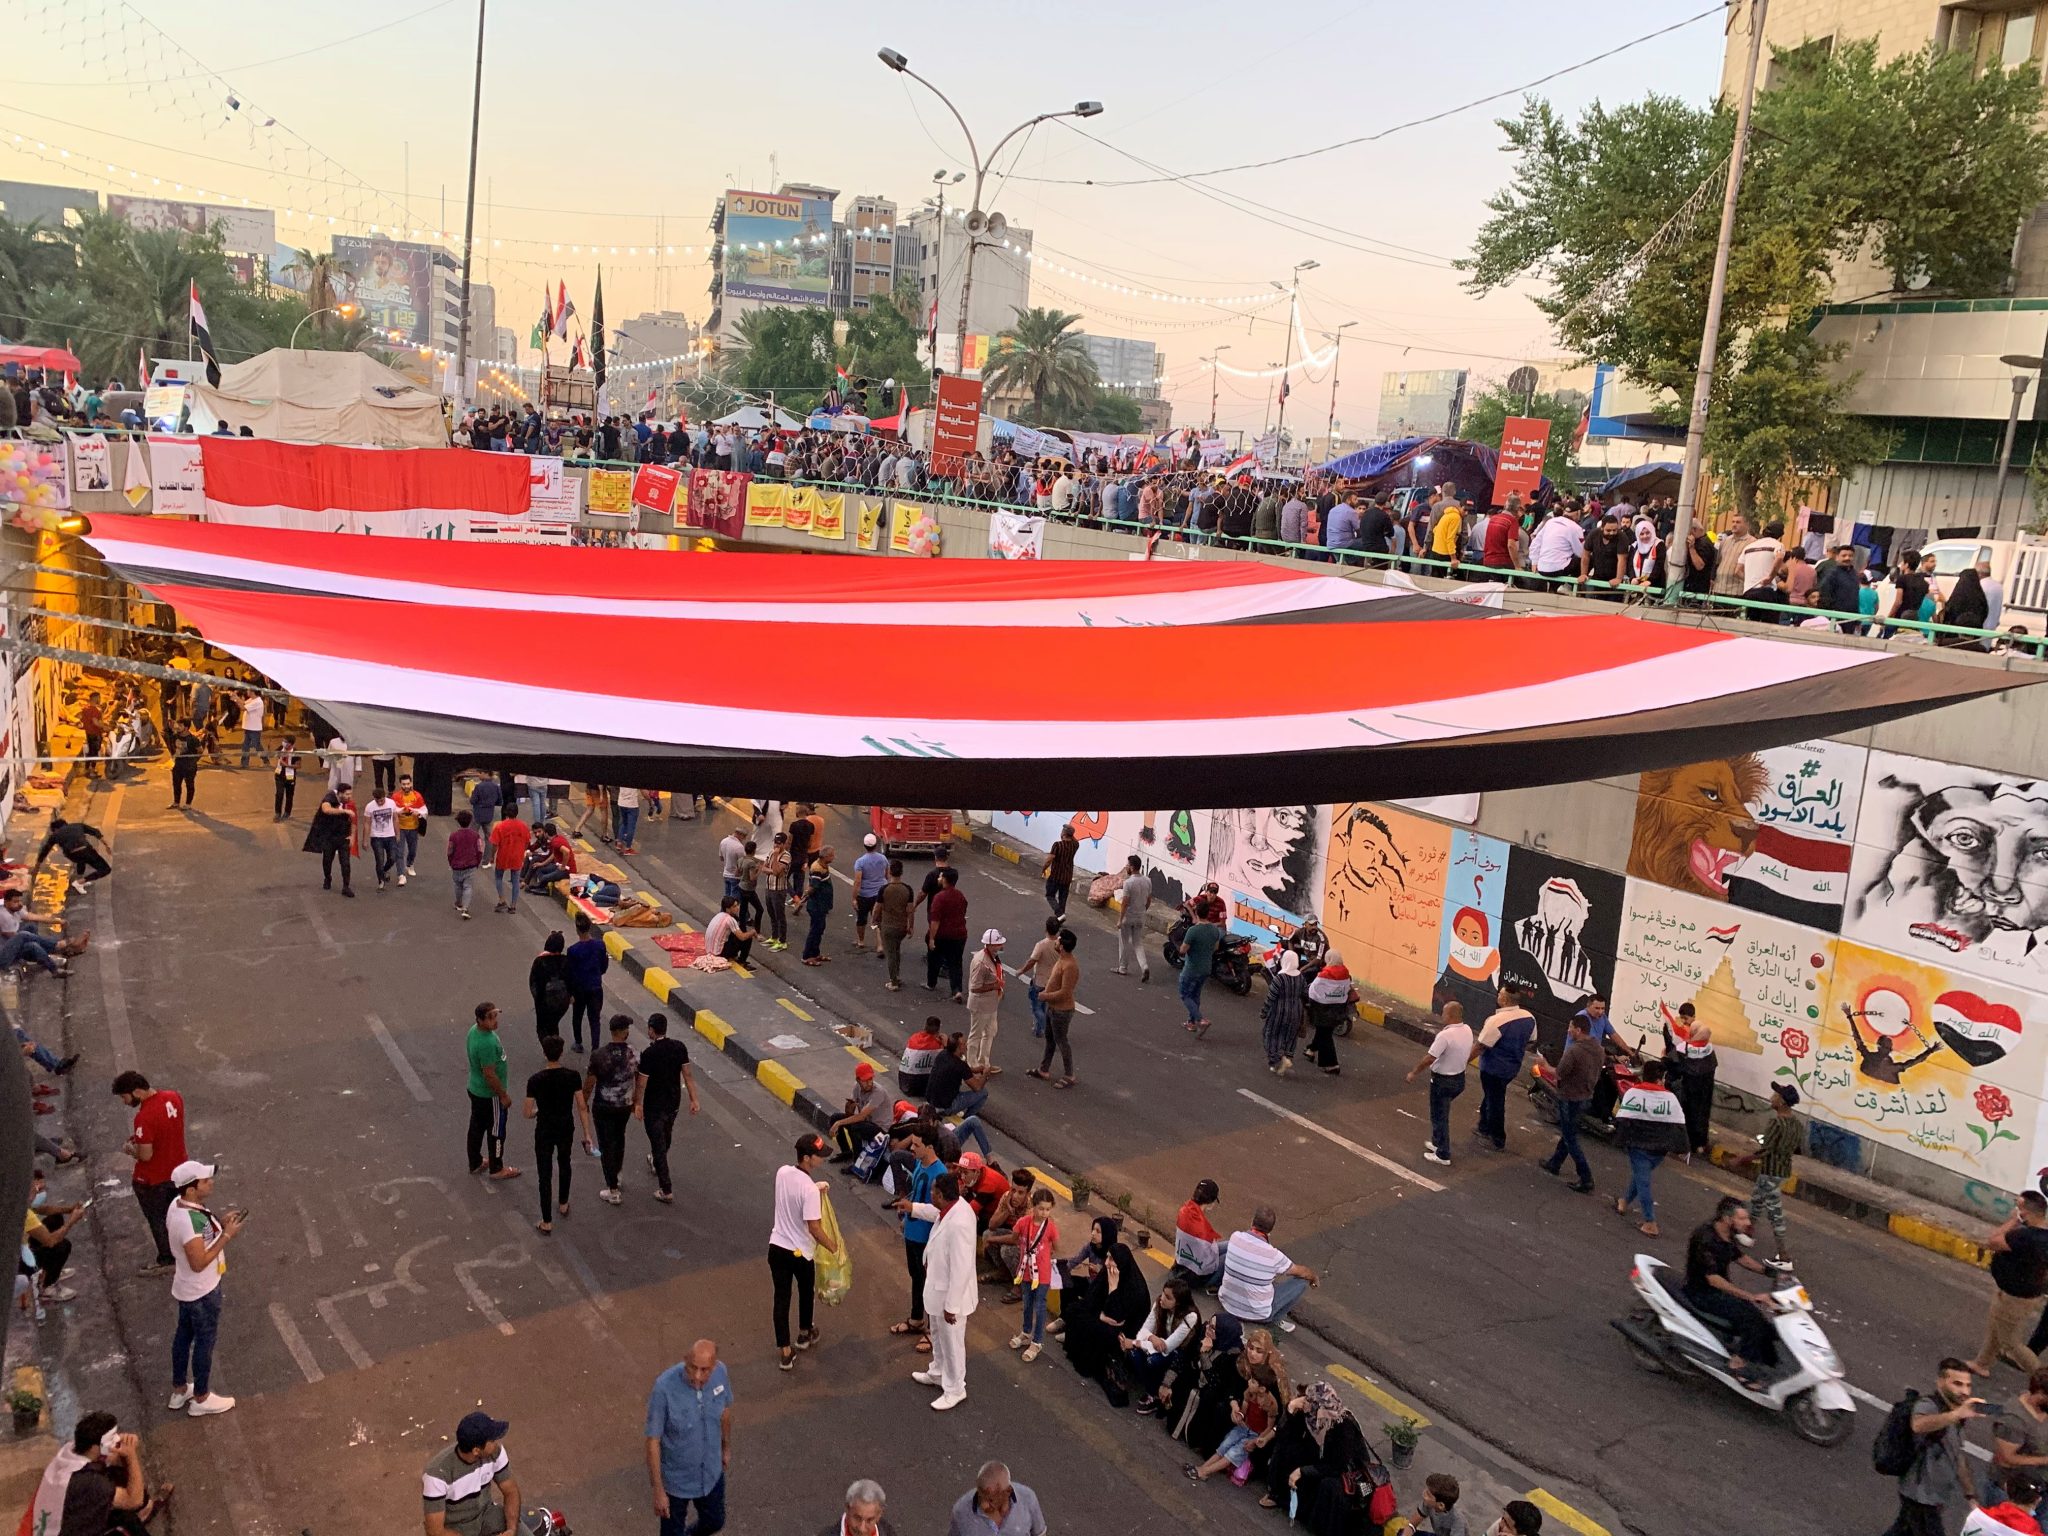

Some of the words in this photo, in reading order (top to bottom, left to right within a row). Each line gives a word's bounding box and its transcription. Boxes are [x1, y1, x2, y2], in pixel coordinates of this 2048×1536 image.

[748, 199, 799, 218] JOTUN
[1778, 773, 1844, 810] العراق
[1814, 811, 1847, 839] بلد
[1478, 856, 1502, 872] سوف
[1629, 906, 1654, 924] غرسوا
[1680, 922, 1697, 934] هم
[1746, 940, 1778, 957] العراق
[1655, 956, 1683, 974] الجراح
[1684, 964, 1702, 980] فوق
[1758, 985, 1769, 1001] أن
[1758, 1012, 1785, 1029] تغفل
[1760, 1032, 1780, 1044] عنه
[1978, 1024, 2001, 1041] الله
[1815, 1045, 1854, 1063] شمس
[1813, 1064, 1850, 1090] الحرية
[166, 1100, 178, 1118] 4
[1652, 1100, 1672, 1116] الله
[1854, 1088, 1910, 1122] أشرقت
[1914, 1086, 1948, 1116] لقد
[136, 1126, 144, 1138] 4
